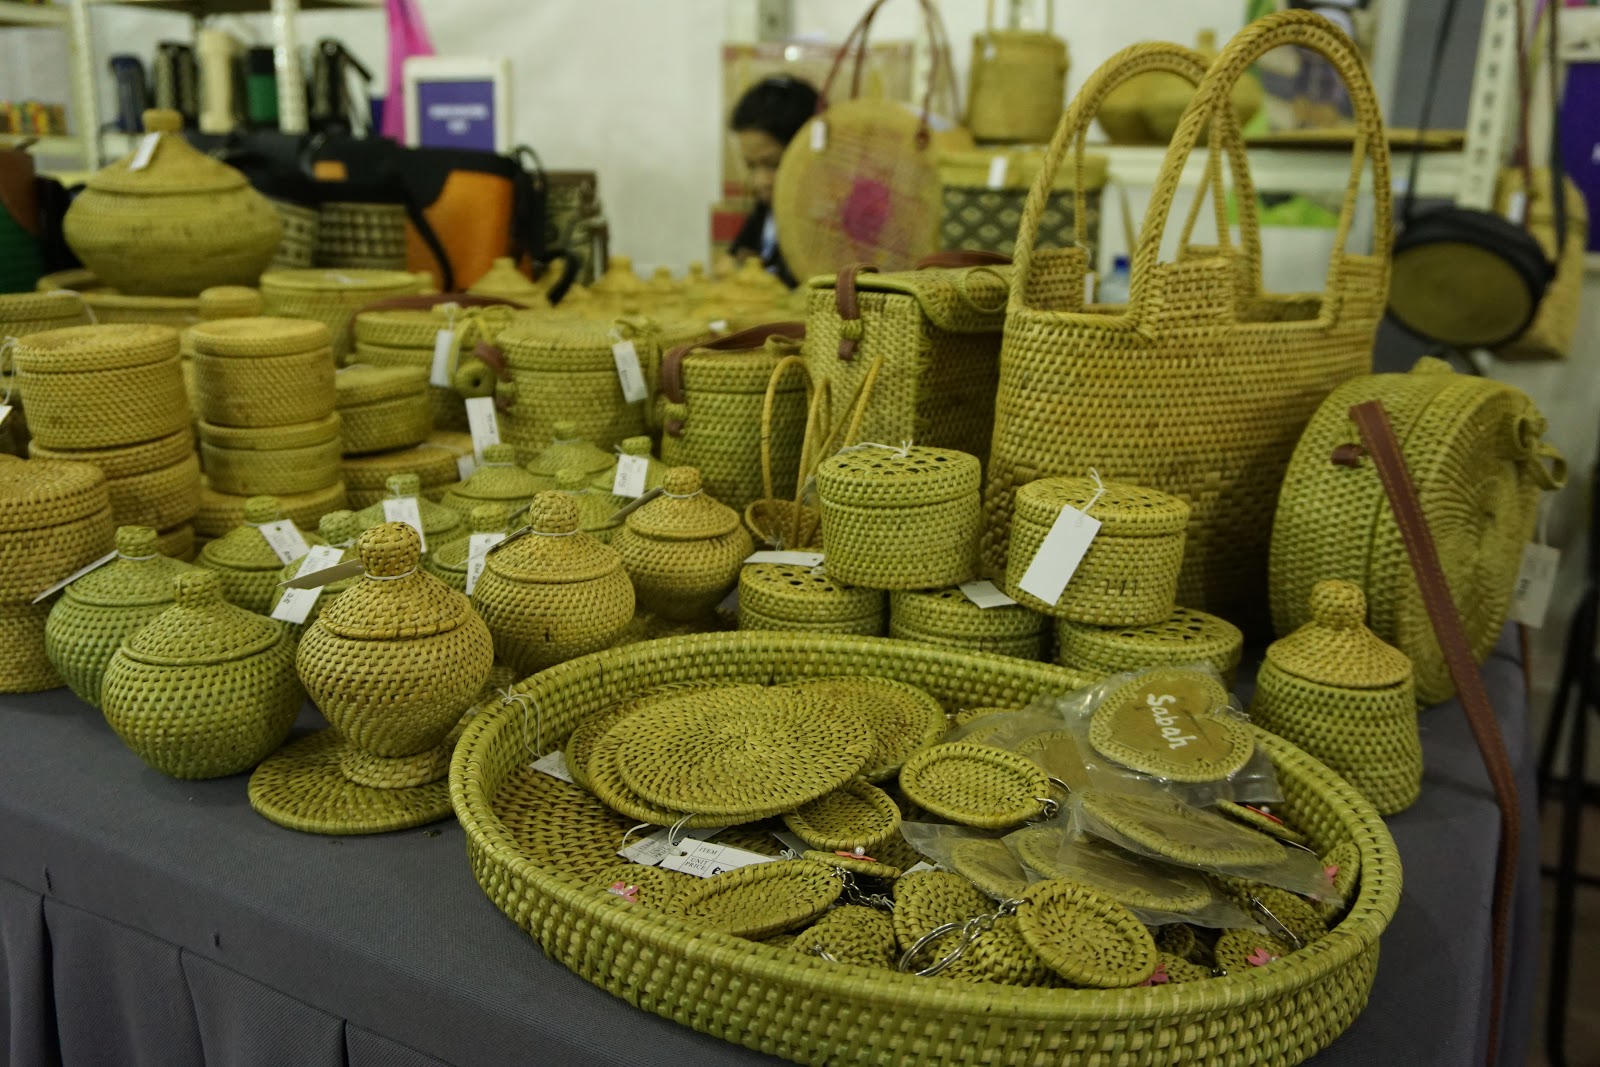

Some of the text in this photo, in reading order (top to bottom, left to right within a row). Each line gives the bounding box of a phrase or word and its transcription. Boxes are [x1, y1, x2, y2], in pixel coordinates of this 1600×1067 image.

[1146, 693, 1198, 750] Sabah
[698, 846, 718, 856] ITEM
[684, 861, 708, 871] PRICE
[690, 857, 710, 866] UNIT
